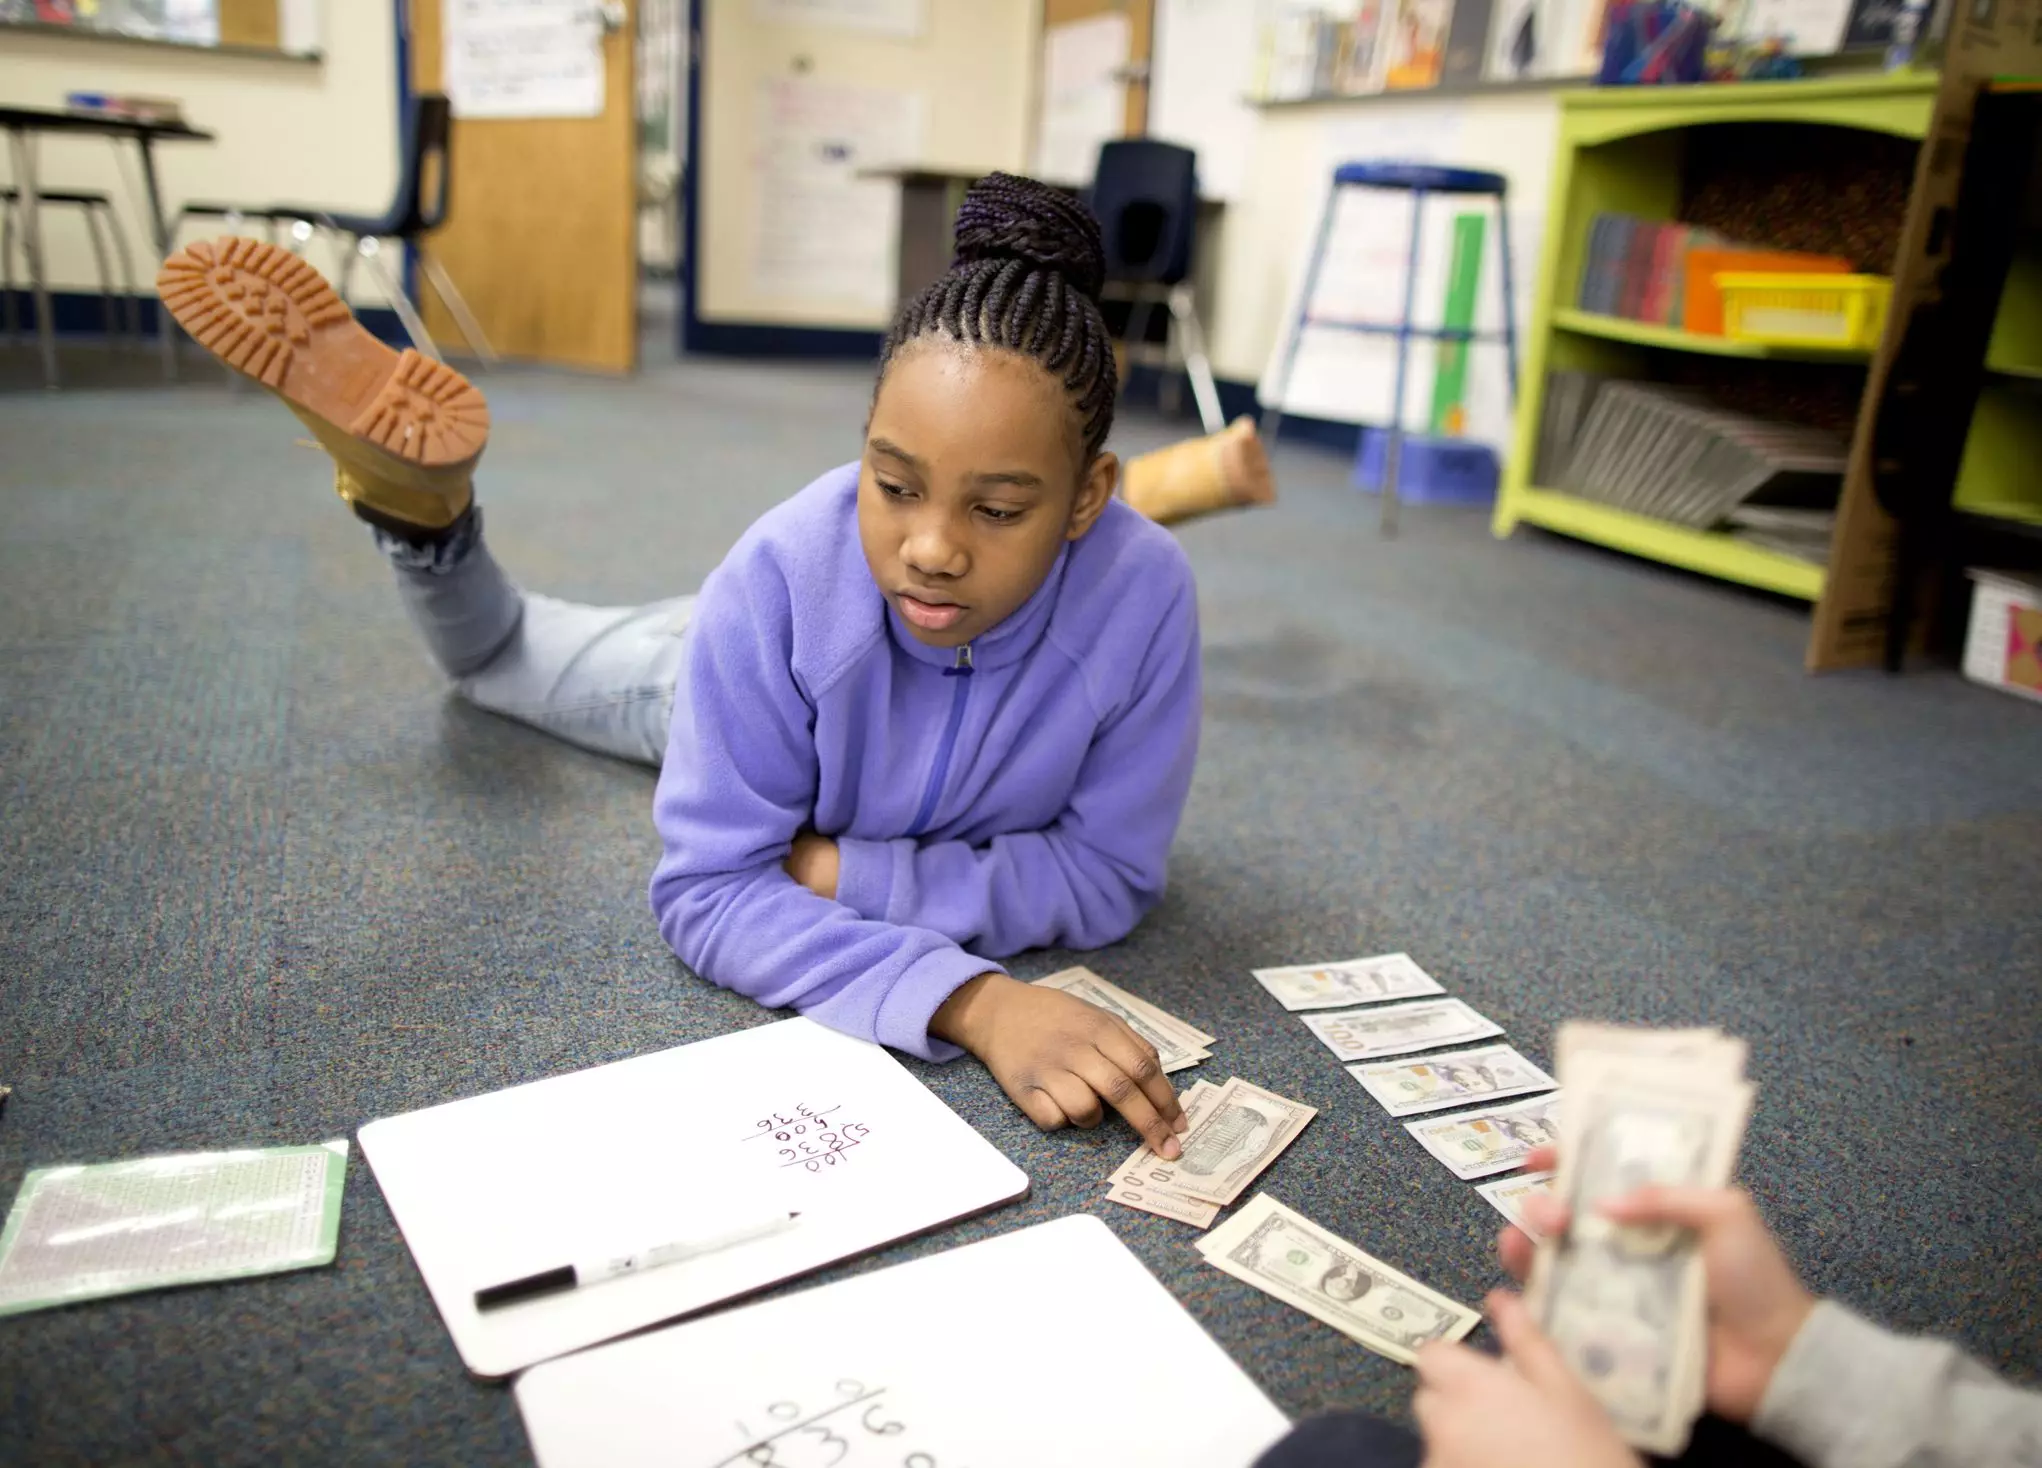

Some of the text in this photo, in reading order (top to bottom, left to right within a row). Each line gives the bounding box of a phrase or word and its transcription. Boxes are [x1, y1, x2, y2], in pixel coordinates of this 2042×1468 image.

[1323, 1021, 1364, 1051] 100
[756, 1102, 814, 1132] 336
[775, 1115, 829, 1142] 500
[805, 1149, 847, 1173] 100
[1148, 1167, 1177, 1184] 10
